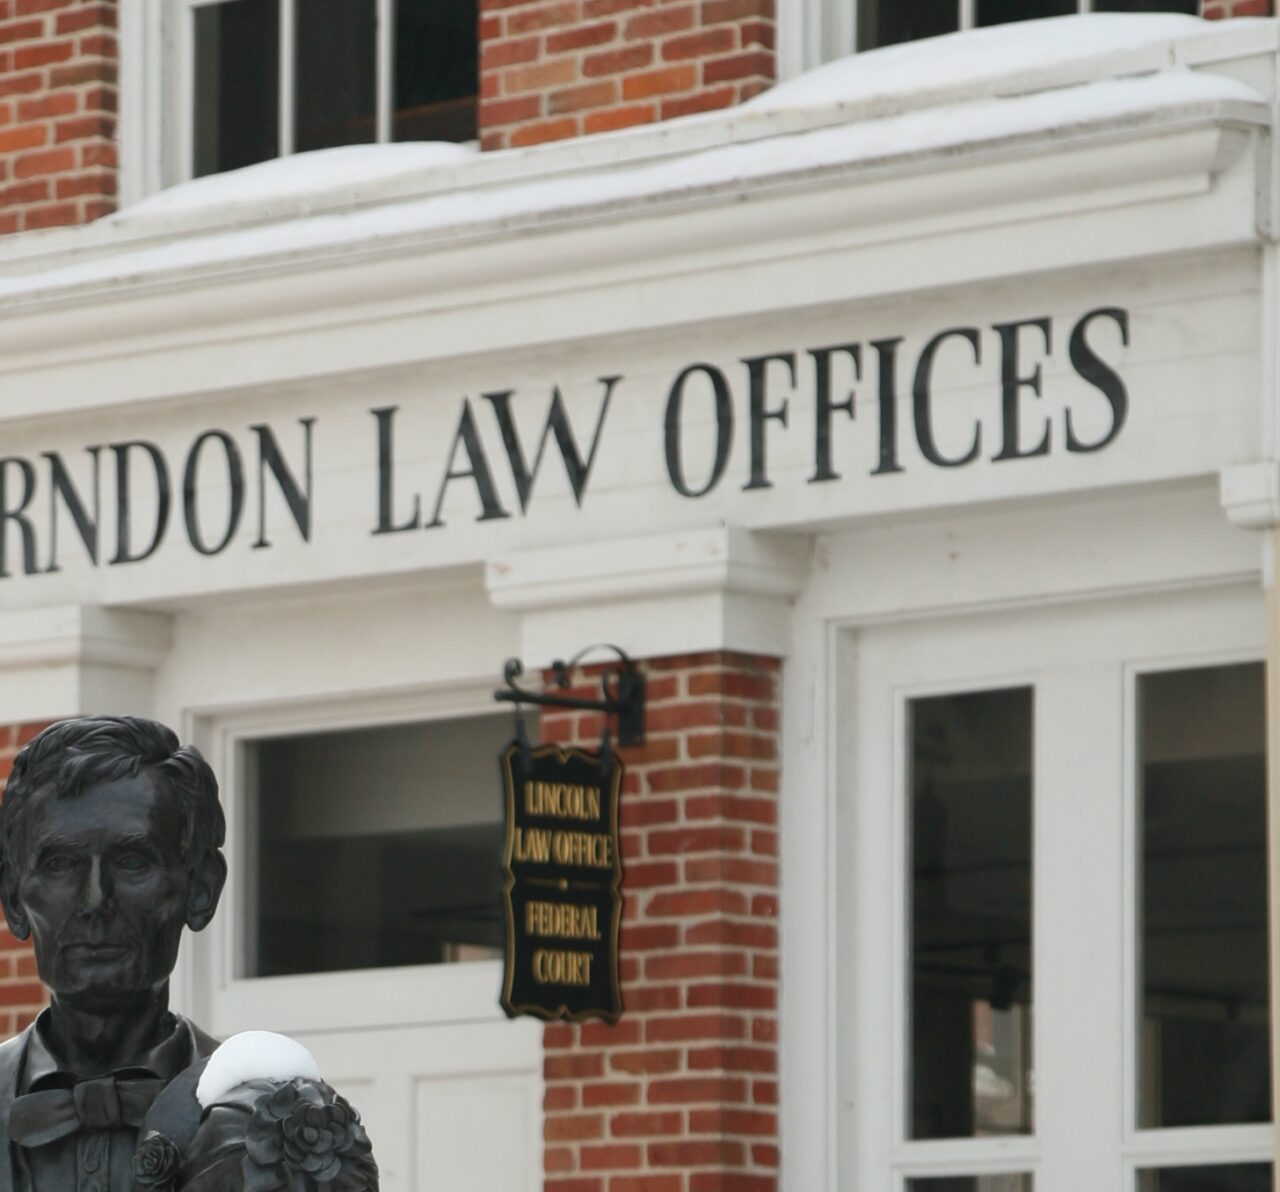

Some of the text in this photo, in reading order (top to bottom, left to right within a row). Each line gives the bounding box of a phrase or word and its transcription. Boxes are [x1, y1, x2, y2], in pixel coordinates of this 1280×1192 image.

[370, 375, 625, 536] LAW
[663, 305, 1132, 499] OFFICES
[525, 780, 600, 822] LINCOLN
[513, 826, 612, 870] LAW OFFICE
[525, 900, 602, 941] FEDERAL
[532, 951, 594, 986] COURT
